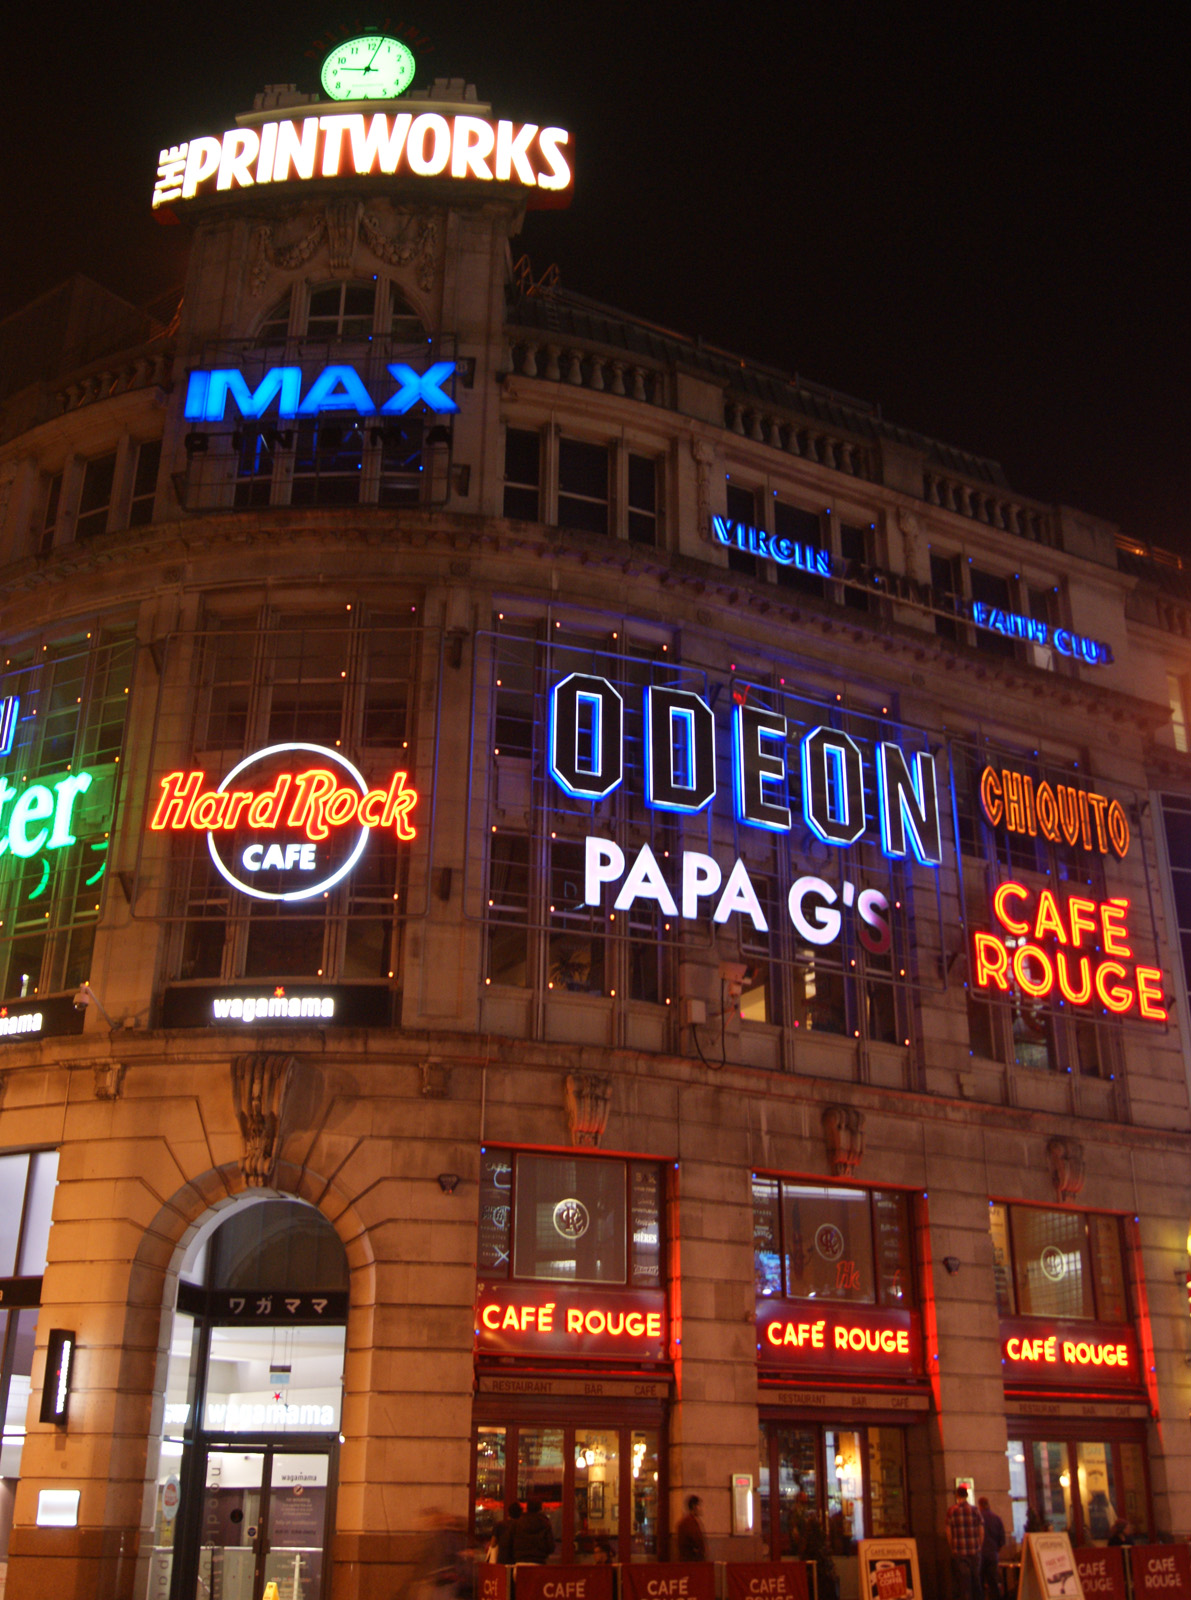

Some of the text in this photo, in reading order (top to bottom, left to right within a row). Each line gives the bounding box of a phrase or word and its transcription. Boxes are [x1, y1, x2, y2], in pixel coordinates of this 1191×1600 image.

[350, 47, 359, 55] 11
[367, 43, 377, 51] 12
[337, 57, 347, 65] 10
[396, 54, 402, 62] 2
[332, 69, 338, 78] 9
[399, 66, 405, 74] 3
[335, 81, 341, 89] 8
[382, 88, 387, 96] 5
[394, 78, 399, 86] 4
[346, 90, 351, 98] 7
[152, 113, 571, 209] THE PRINTWORKS
[184, 361, 461, 422] IMAX
[711, 514, 832, 578] VIRGIN
[549, 672, 942, 868] ODEON
[151, 769, 418, 840] Hard Rock
[981, 765, 1130, 858] CHIQUITO
[242, 844, 317, 872] CAFE
[585, 836, 769, 932] PAPA
[994, 881, 1133, 957] CAFÉ
[975, 932, 1167, 1020] ROUGE
[213, 997, 335, 1022] wagamama
[229, 1295, 328, 1315] ワガママ
[482, 1302, 661, 1337] CAFÉ ROUGE
[767, 1321, 909, 1353] CAFÉ ROUGE
[1007, 1336, 1128, 1366] CAFÉ ROUGE
[492, 1380, 553, 1393] RESTAURANT
[584, 1384, 604, 1395] BAR
[778, 1393, 826, 1406] RESTAURANT
[208, 1402, 334, 1427] wagamama
[281, 1474, 317, 1483] wagamama
[543, 1579, 587, 1599] CAFÉ
[647, 1576, 690, 1596] CAFÉ
[750, 1575, 786, 1594] CAFÉ
[1081, 1577, 1114, 1592] OUGE
[1145, 1573, 1182, 1588] ROUGE
